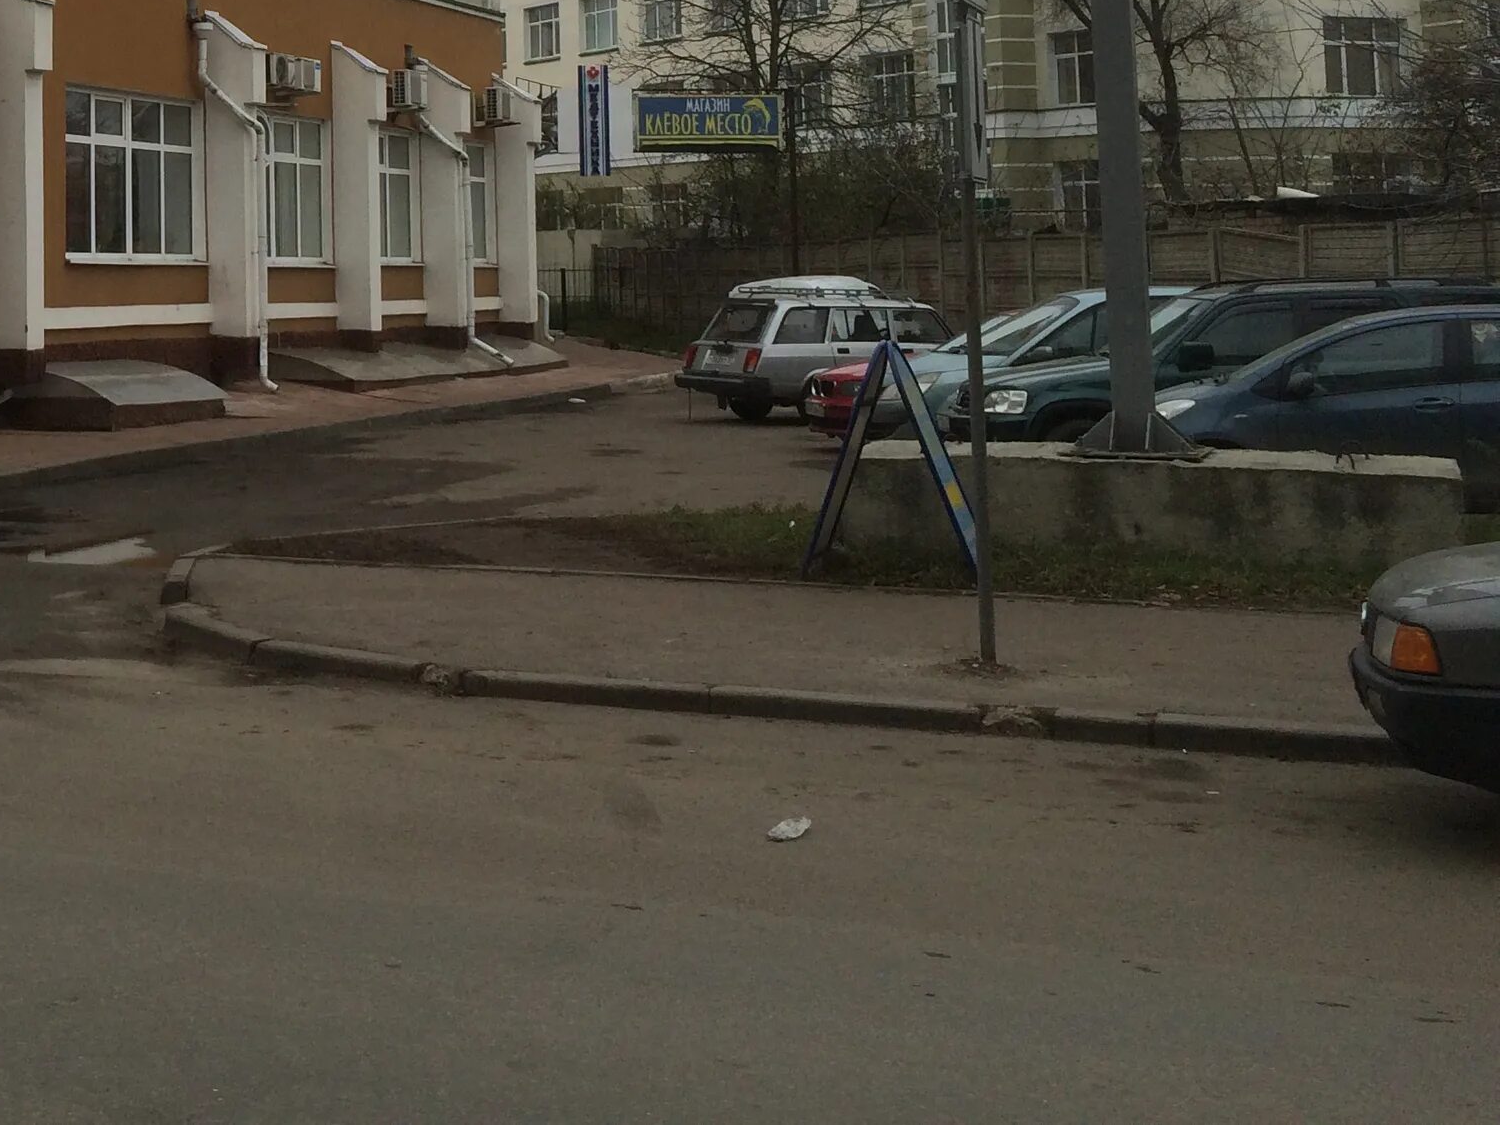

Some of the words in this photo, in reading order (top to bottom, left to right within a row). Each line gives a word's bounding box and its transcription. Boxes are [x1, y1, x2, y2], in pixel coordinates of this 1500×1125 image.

[686, 98, 731, 113] МАГАЗИН
[645, 112, 700, 135] КЛЁВОЕ
[705, 113, 752, 135] МЕСТО
